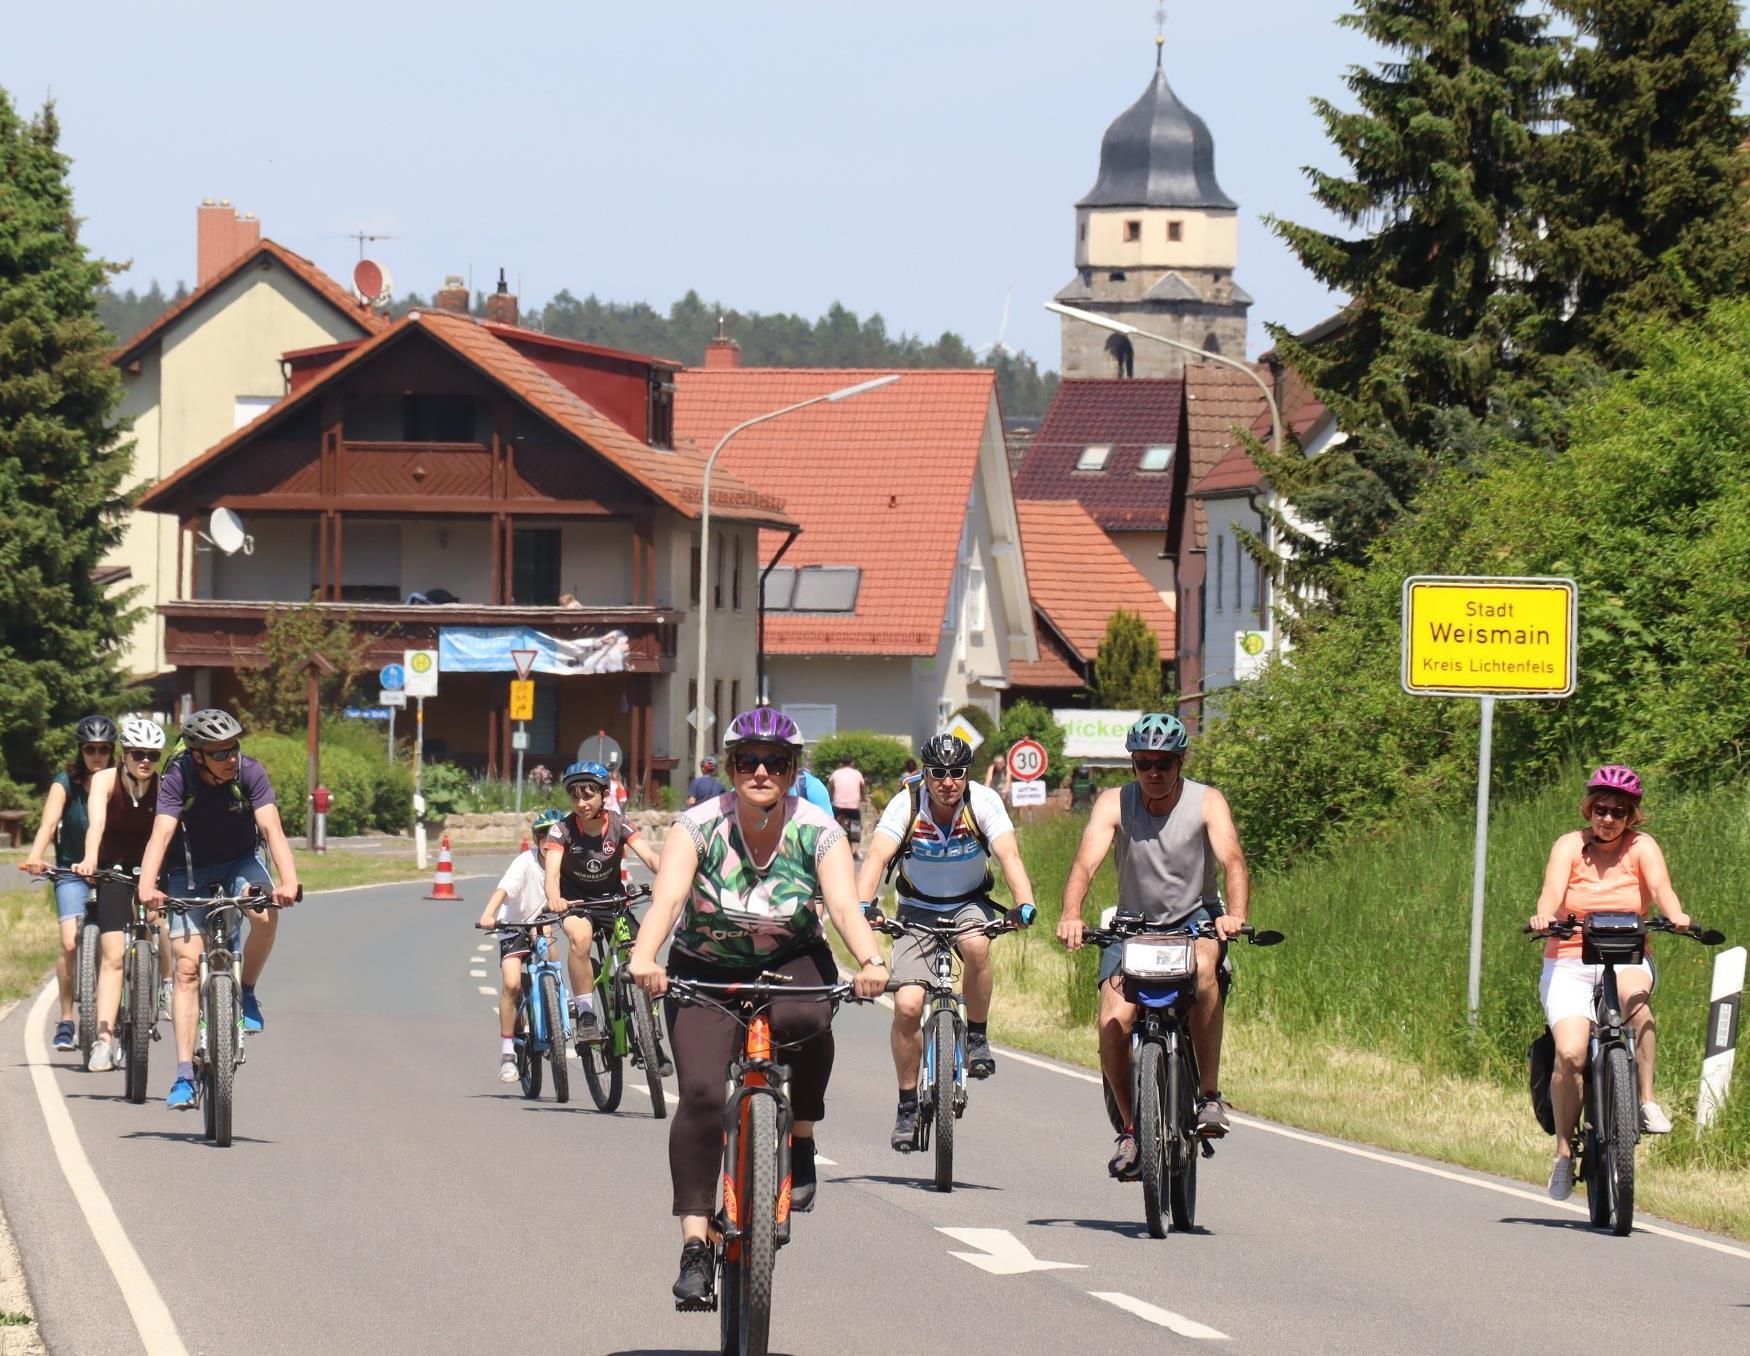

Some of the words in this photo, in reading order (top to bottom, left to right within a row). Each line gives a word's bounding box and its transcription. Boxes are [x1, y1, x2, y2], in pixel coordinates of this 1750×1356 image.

[1465, 601, 1515, 617] Stadt
[1430, 622, 1550, 645] Weismain
[1423, 658, 1462, 671] Kreis
[1470, 658, 1554, 673] Lichtenfels
[1065, 719, 1129, 737] dicke
[1016, 752, 1038, 770] 30
[911, 840, 979, 858] CUBE
